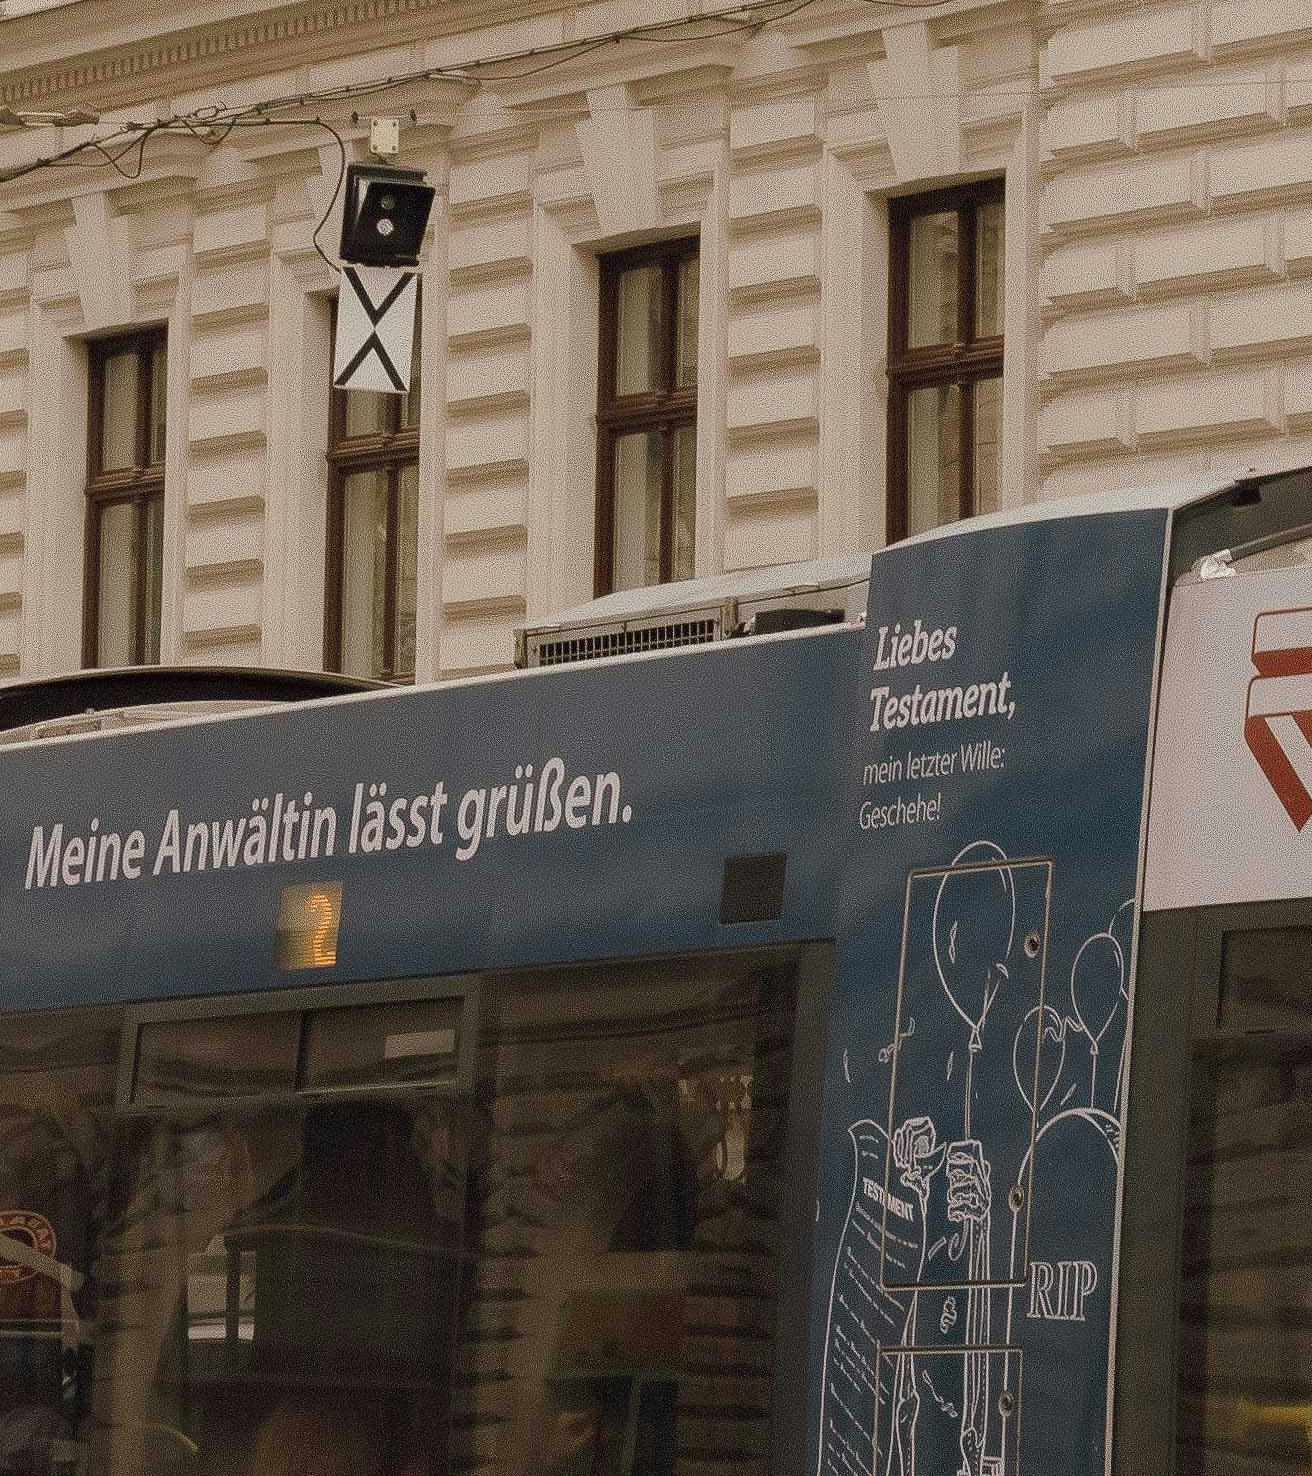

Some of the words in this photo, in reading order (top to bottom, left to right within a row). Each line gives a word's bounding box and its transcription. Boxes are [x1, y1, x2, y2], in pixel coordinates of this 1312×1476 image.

[872, 619, 958, 672] Liebes
[869, 671, 1016, 733] Testament,
[863, 755, 902, 786] mein
[906, 751, 957, 780] letzter
[960, 740, 1005, 772] Wille:
[24, 820, 144, 890] Meine
[152, 790, 338, 876] Anwältin
[347, 780, 449, 854] lässt
[456, 756, 634, 862] grüßen.
[859, 792, 942, 831] Geschehe!
[308, 892, 337, 967] 2
[1026, 1260, 1097, 1321] RIP
